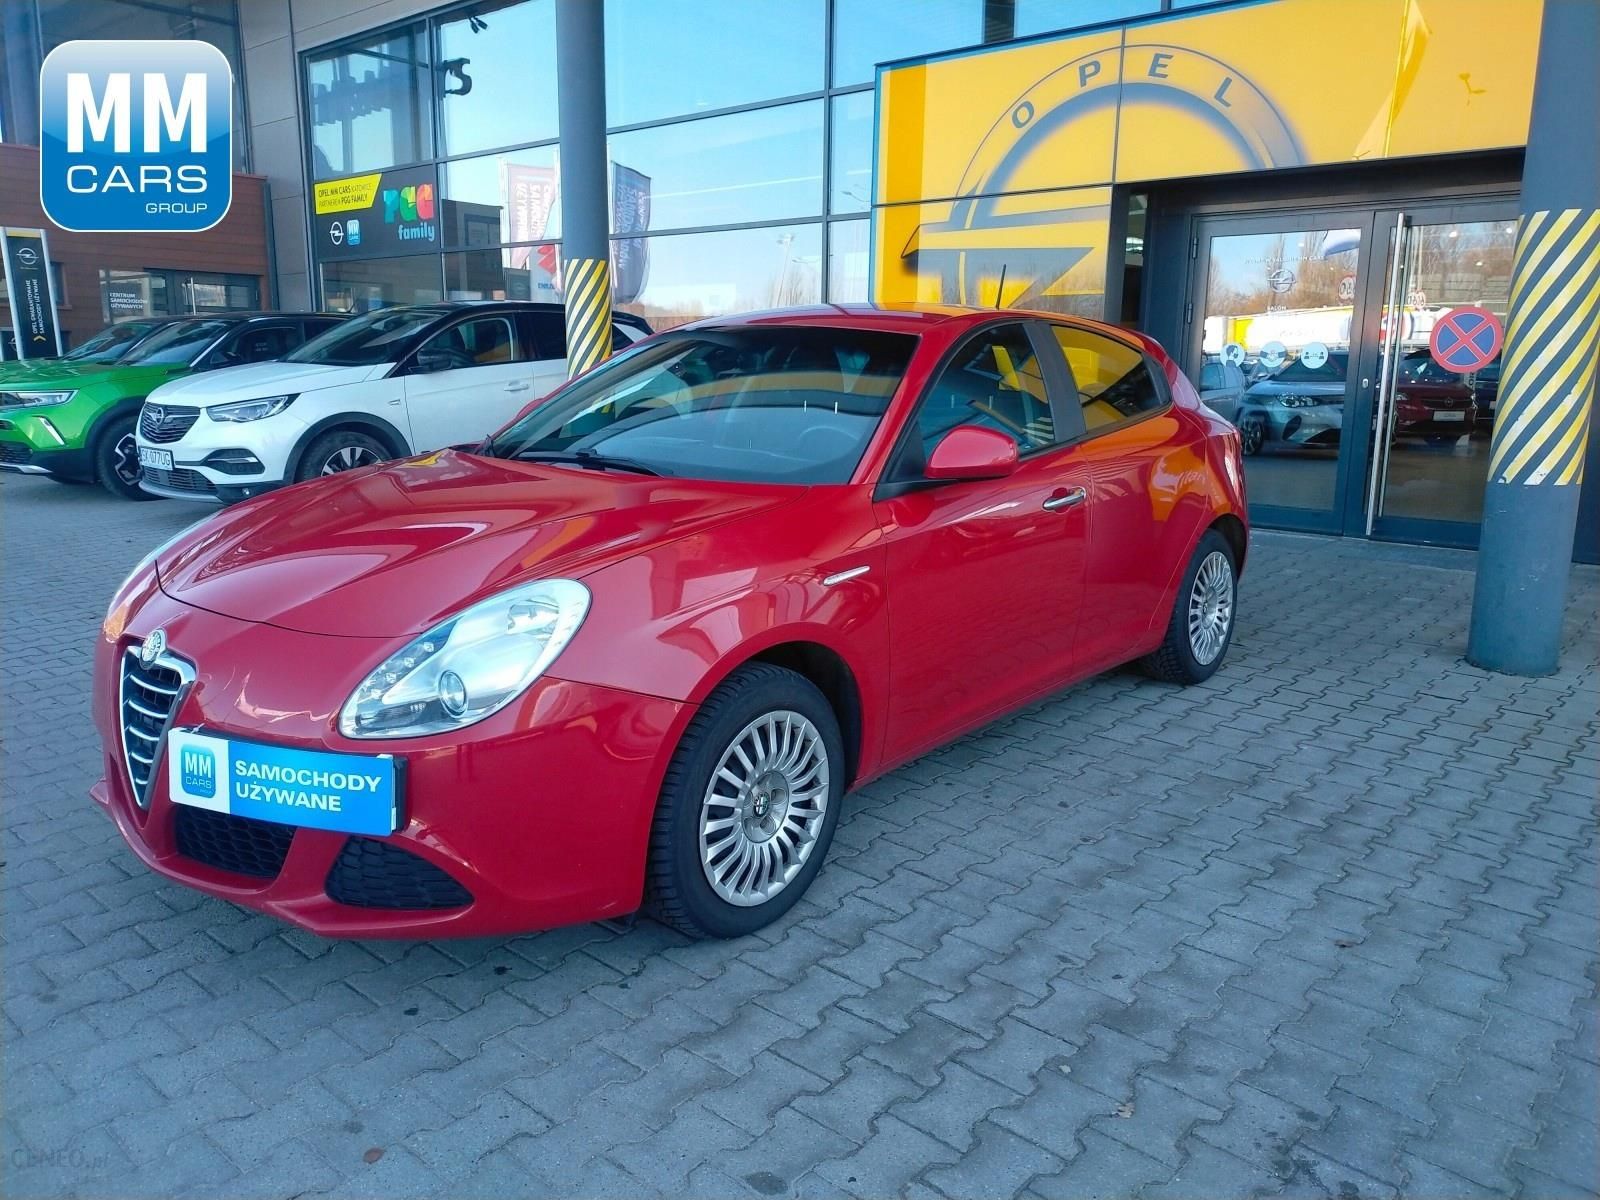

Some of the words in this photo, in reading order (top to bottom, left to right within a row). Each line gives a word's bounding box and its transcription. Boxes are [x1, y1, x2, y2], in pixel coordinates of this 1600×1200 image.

[1011, 53, 1233, 129] OPEL
[398, 222, 435, 242] family
[184, 751, 212, 778] MM
[235, 760, 382, 792] SAMOCHODY
[185, 776, 212, 789] CARS
[235, 781, 342, 812] UŻYWANE
